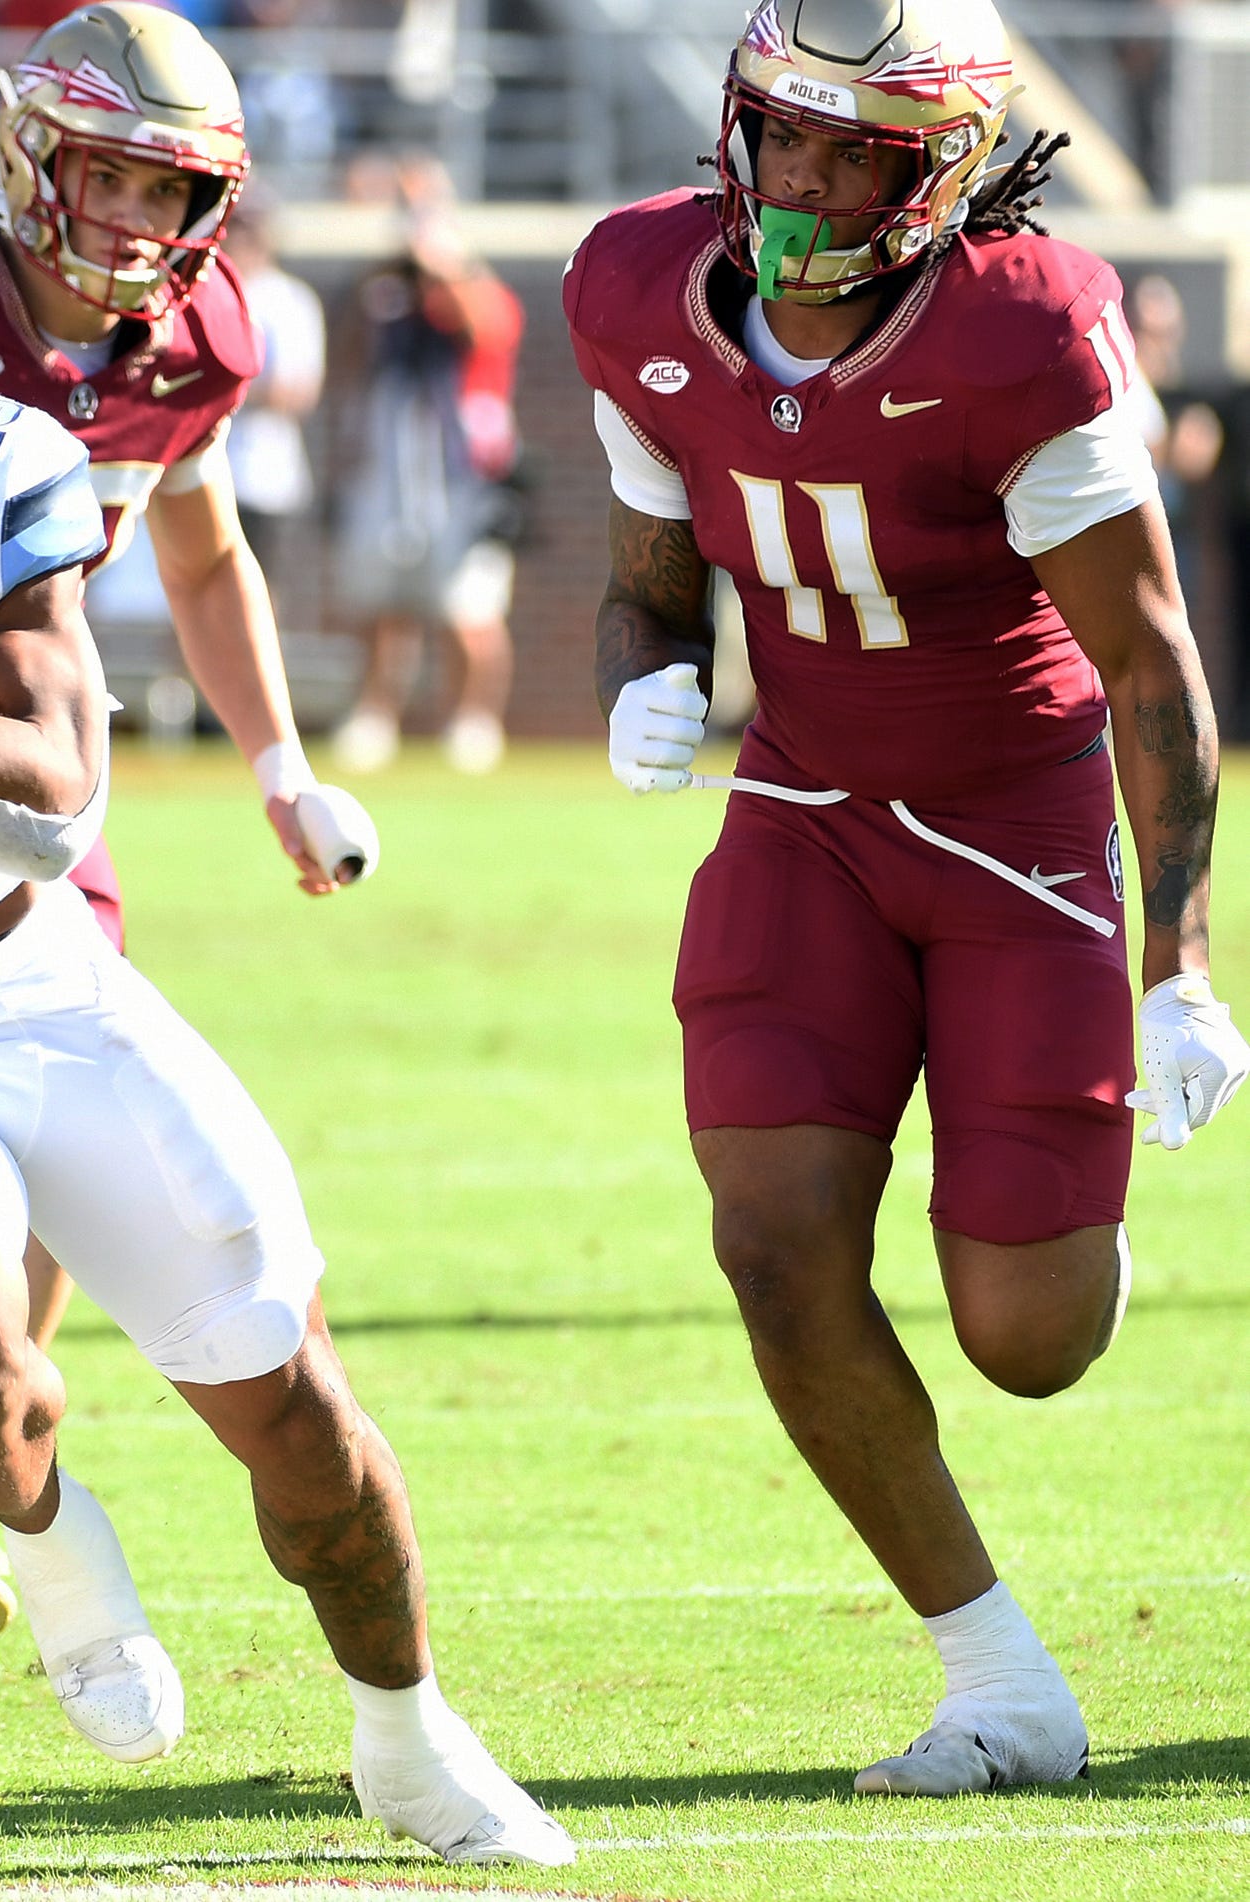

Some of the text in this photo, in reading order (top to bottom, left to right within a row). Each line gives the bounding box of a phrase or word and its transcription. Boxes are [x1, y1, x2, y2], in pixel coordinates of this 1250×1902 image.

[787, 80, 839, 107] NOLES
[646, 365, 683, 381] ACC
[728, 468, 910, 650] 11
